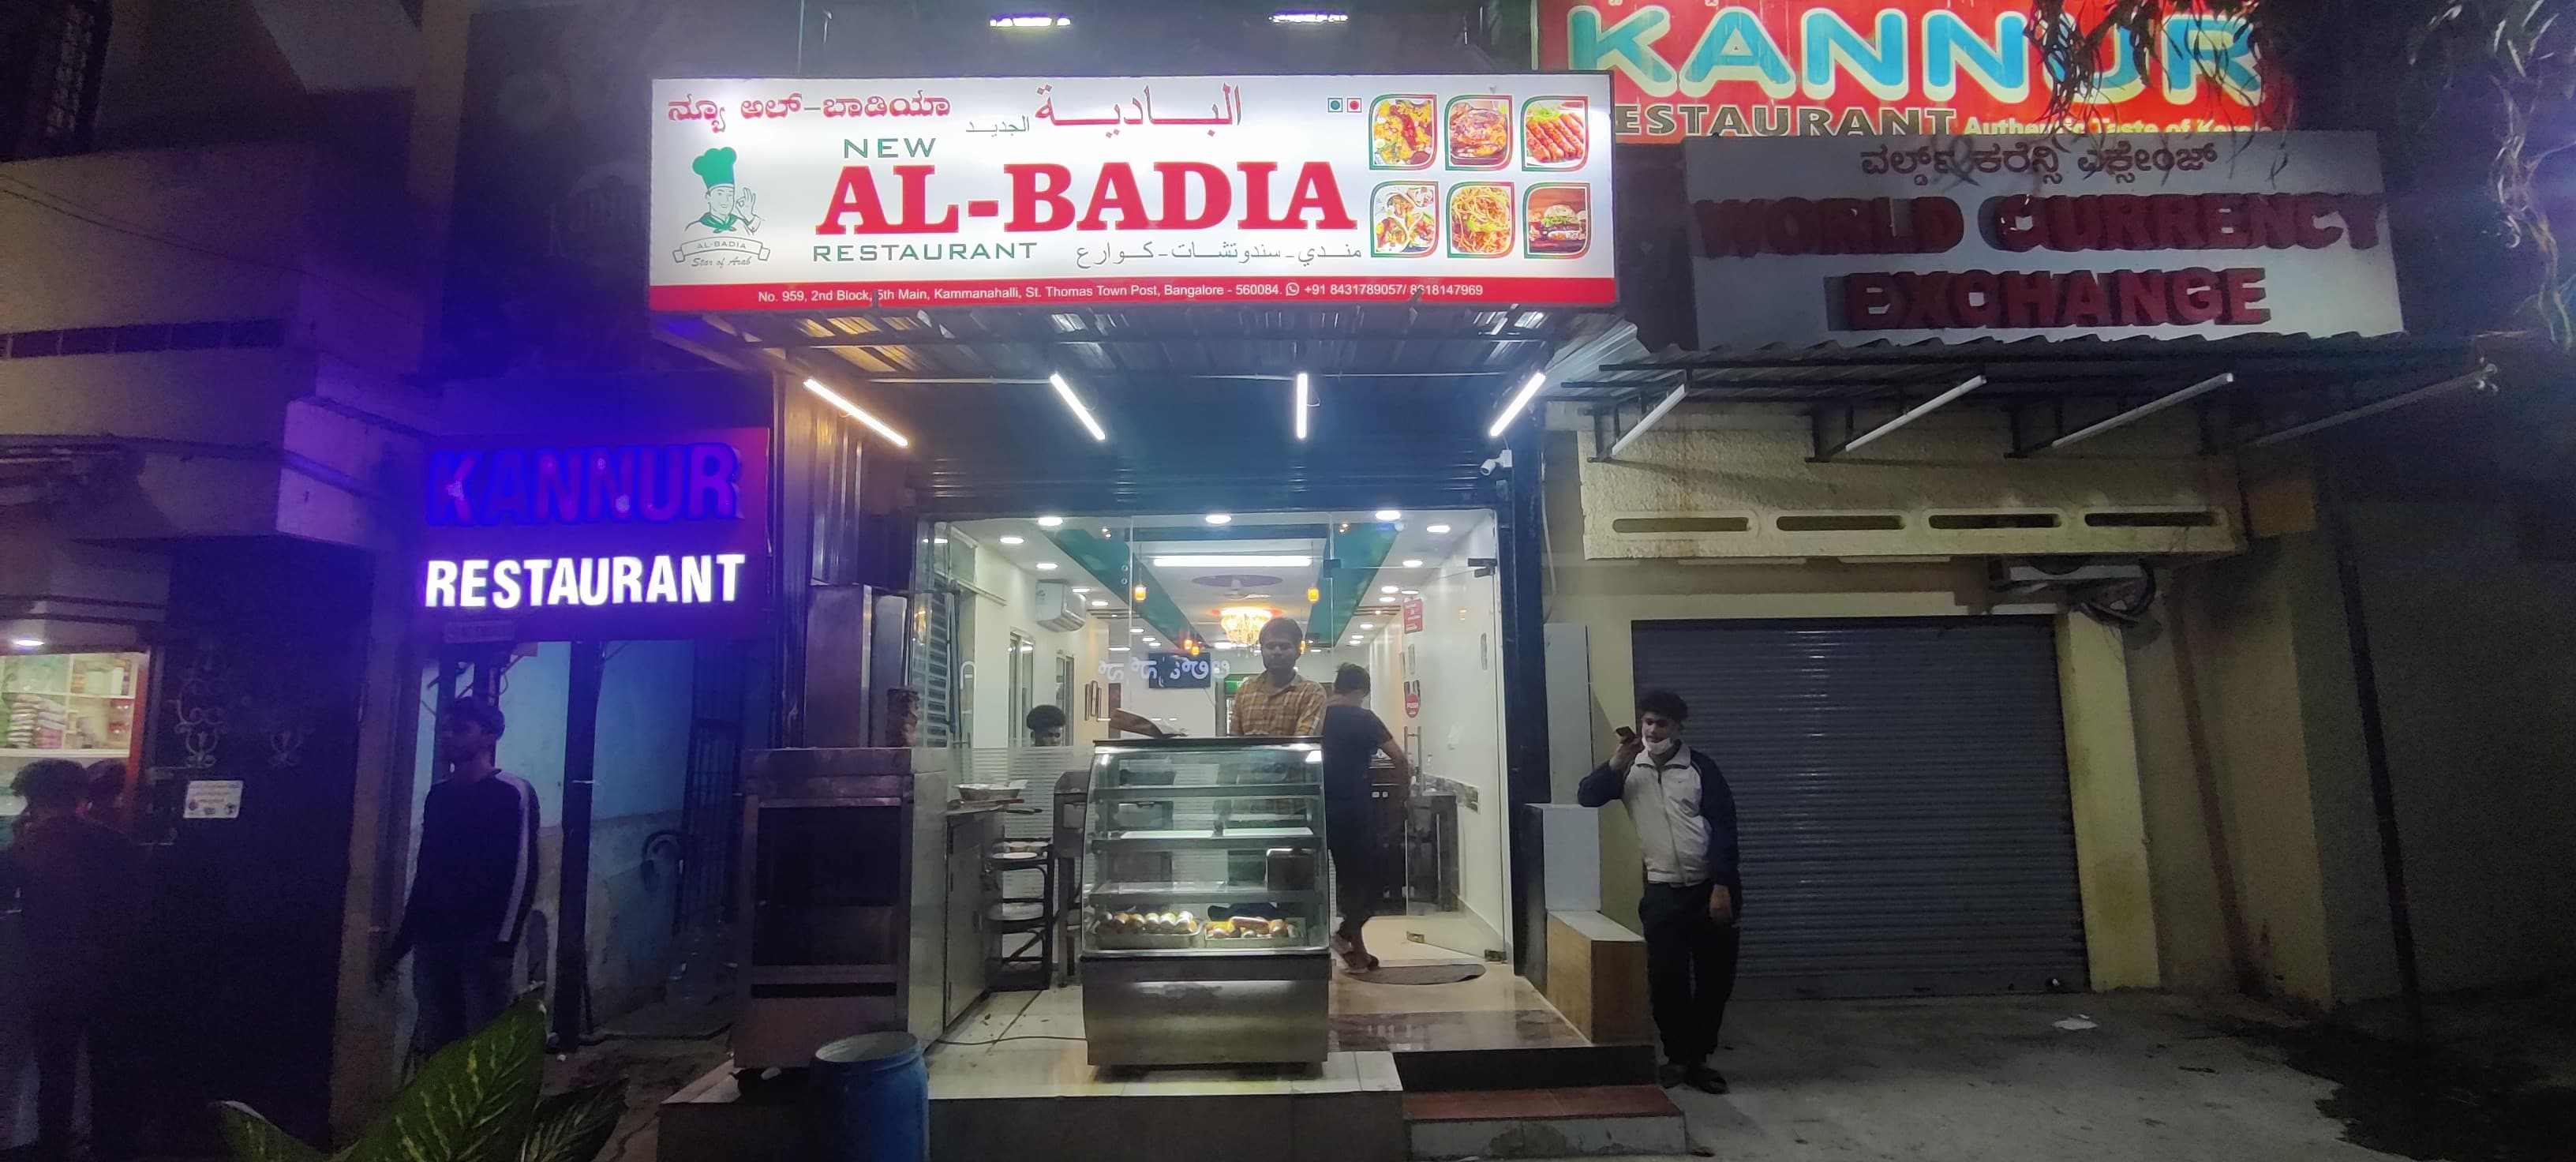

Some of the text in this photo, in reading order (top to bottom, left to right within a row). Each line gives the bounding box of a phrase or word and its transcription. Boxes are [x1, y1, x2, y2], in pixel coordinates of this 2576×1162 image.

[1567, 6, 2265, 106] KANNUR
[1615, 103, 1957, 137] ESTAURANT
[844, 137, 937, 159] NEW
[814, 161, 1357, 235] AL-BADIA
[697, 241, 747, 249] AL-BADIA
[1694, 192, 2383, 257] WORLD CURRENCY
[691, 257, 713, 267] Star
[728, 256, 752, 266] Arab
[814, 242, 1038, 262] RESTAURANT
[758, 291, 778, 302] No.
[782, 290, 807, 302] 959,
[811, 290, 833, 301] 2nd
[837, 289, 872, 302] Block,
[877, 289, 894, 300] 5th
[898, 288, 930, 301] Main,
[934, 287, 1022, 299] Kammanahalli,
[1025, 287, 1041, 297] St.
[1046, 285, 1093, 297] Thomas
[1096, 285, 1127, 296] Town
[1131, 284, 1160, 297] Post,
[1164, 284, 1224, 298] Bangalore
[1235, 284, 1282, 295] 560084.
[1304, 284, 1325, 295] +91
[1330, 284, 1406, 296] 8431789057/
[1826, 267, 2272, 331] EXCHANGE
[427, 442, 739, 527] KANNUR
[425, 553, 746, 609] RESTAURANT
